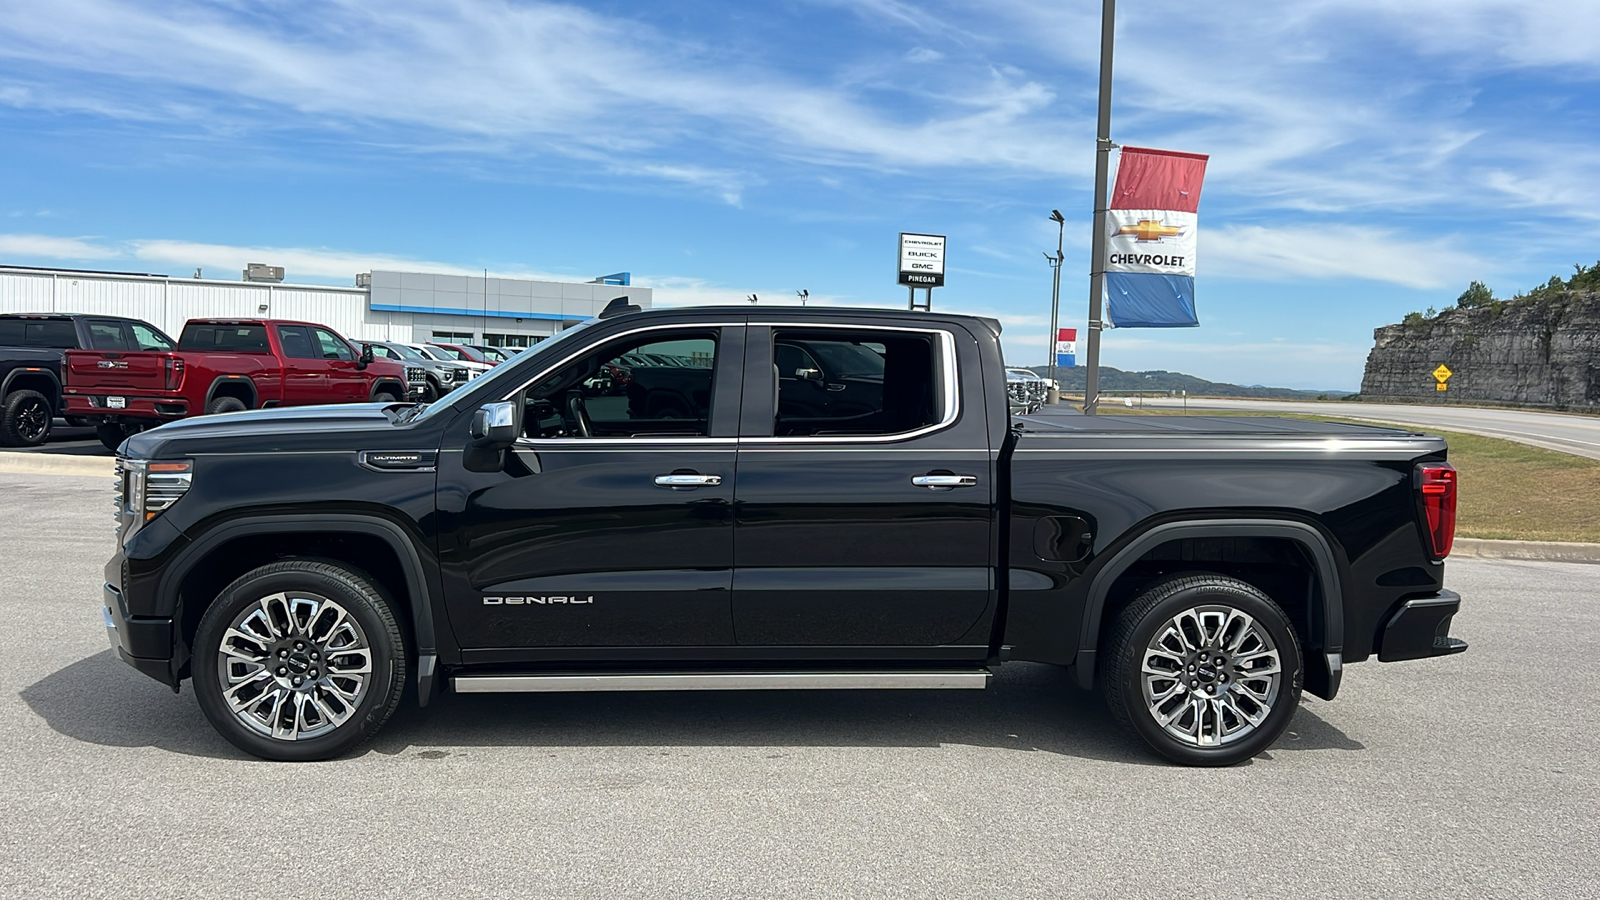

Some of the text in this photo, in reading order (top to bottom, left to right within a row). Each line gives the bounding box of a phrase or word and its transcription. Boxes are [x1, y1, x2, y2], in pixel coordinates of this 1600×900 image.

[1109, 253, 1184, 267] CHEVROLET
[907, 275, 936, 283] PINEGAR
[482, 595, 594, 605] DENALI
